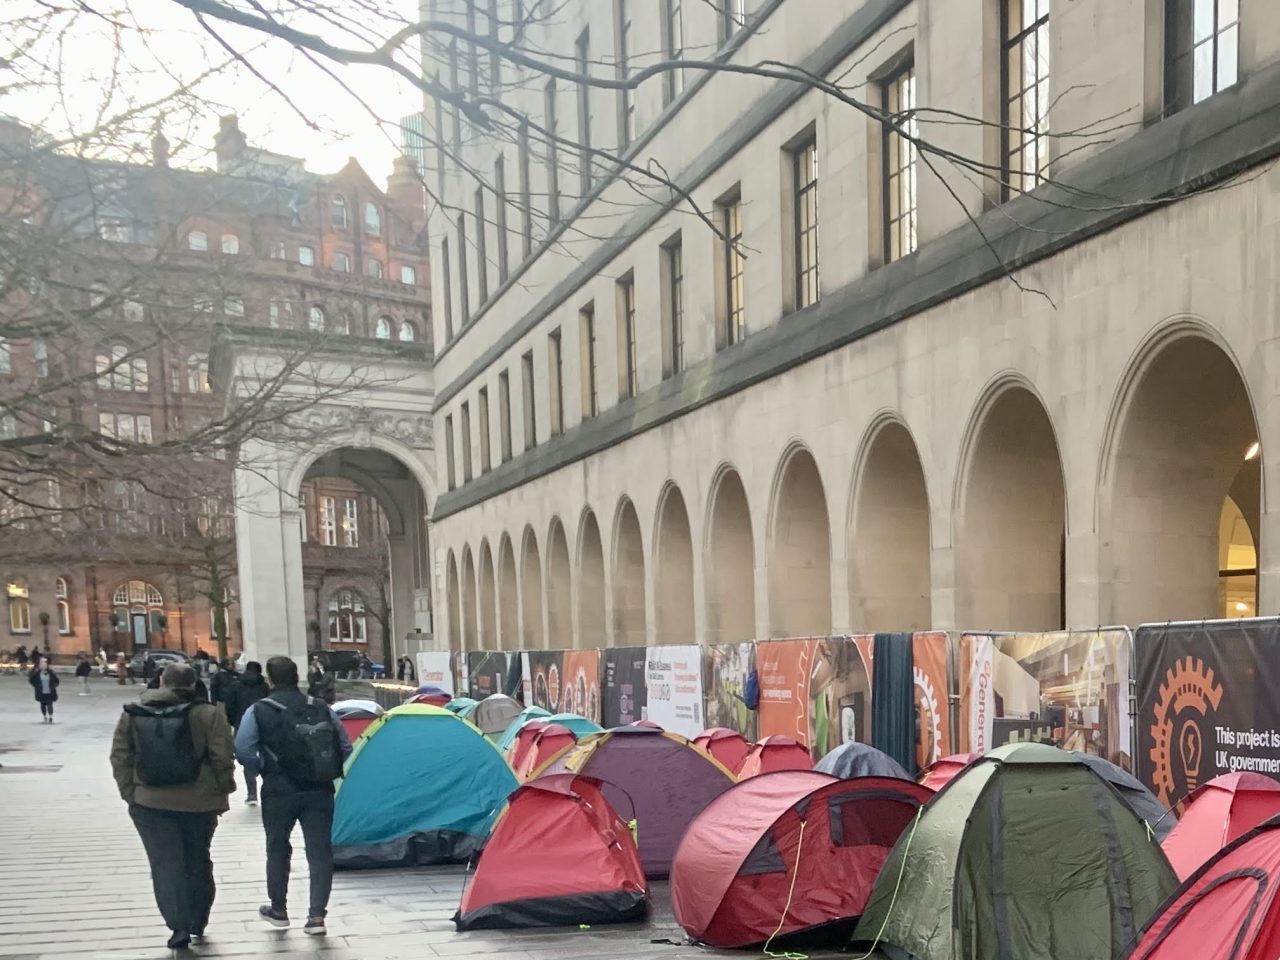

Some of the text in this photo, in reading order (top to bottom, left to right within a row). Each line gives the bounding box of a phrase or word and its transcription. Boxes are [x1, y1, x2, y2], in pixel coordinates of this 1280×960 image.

[976, 672, 988, 755] Generat
[1215, 726, 1235, 745] This
[1236, 728, 1270, 750] project
[1271, 729, 1280, 747] is
[1215, 750, 1229, 768] UK
